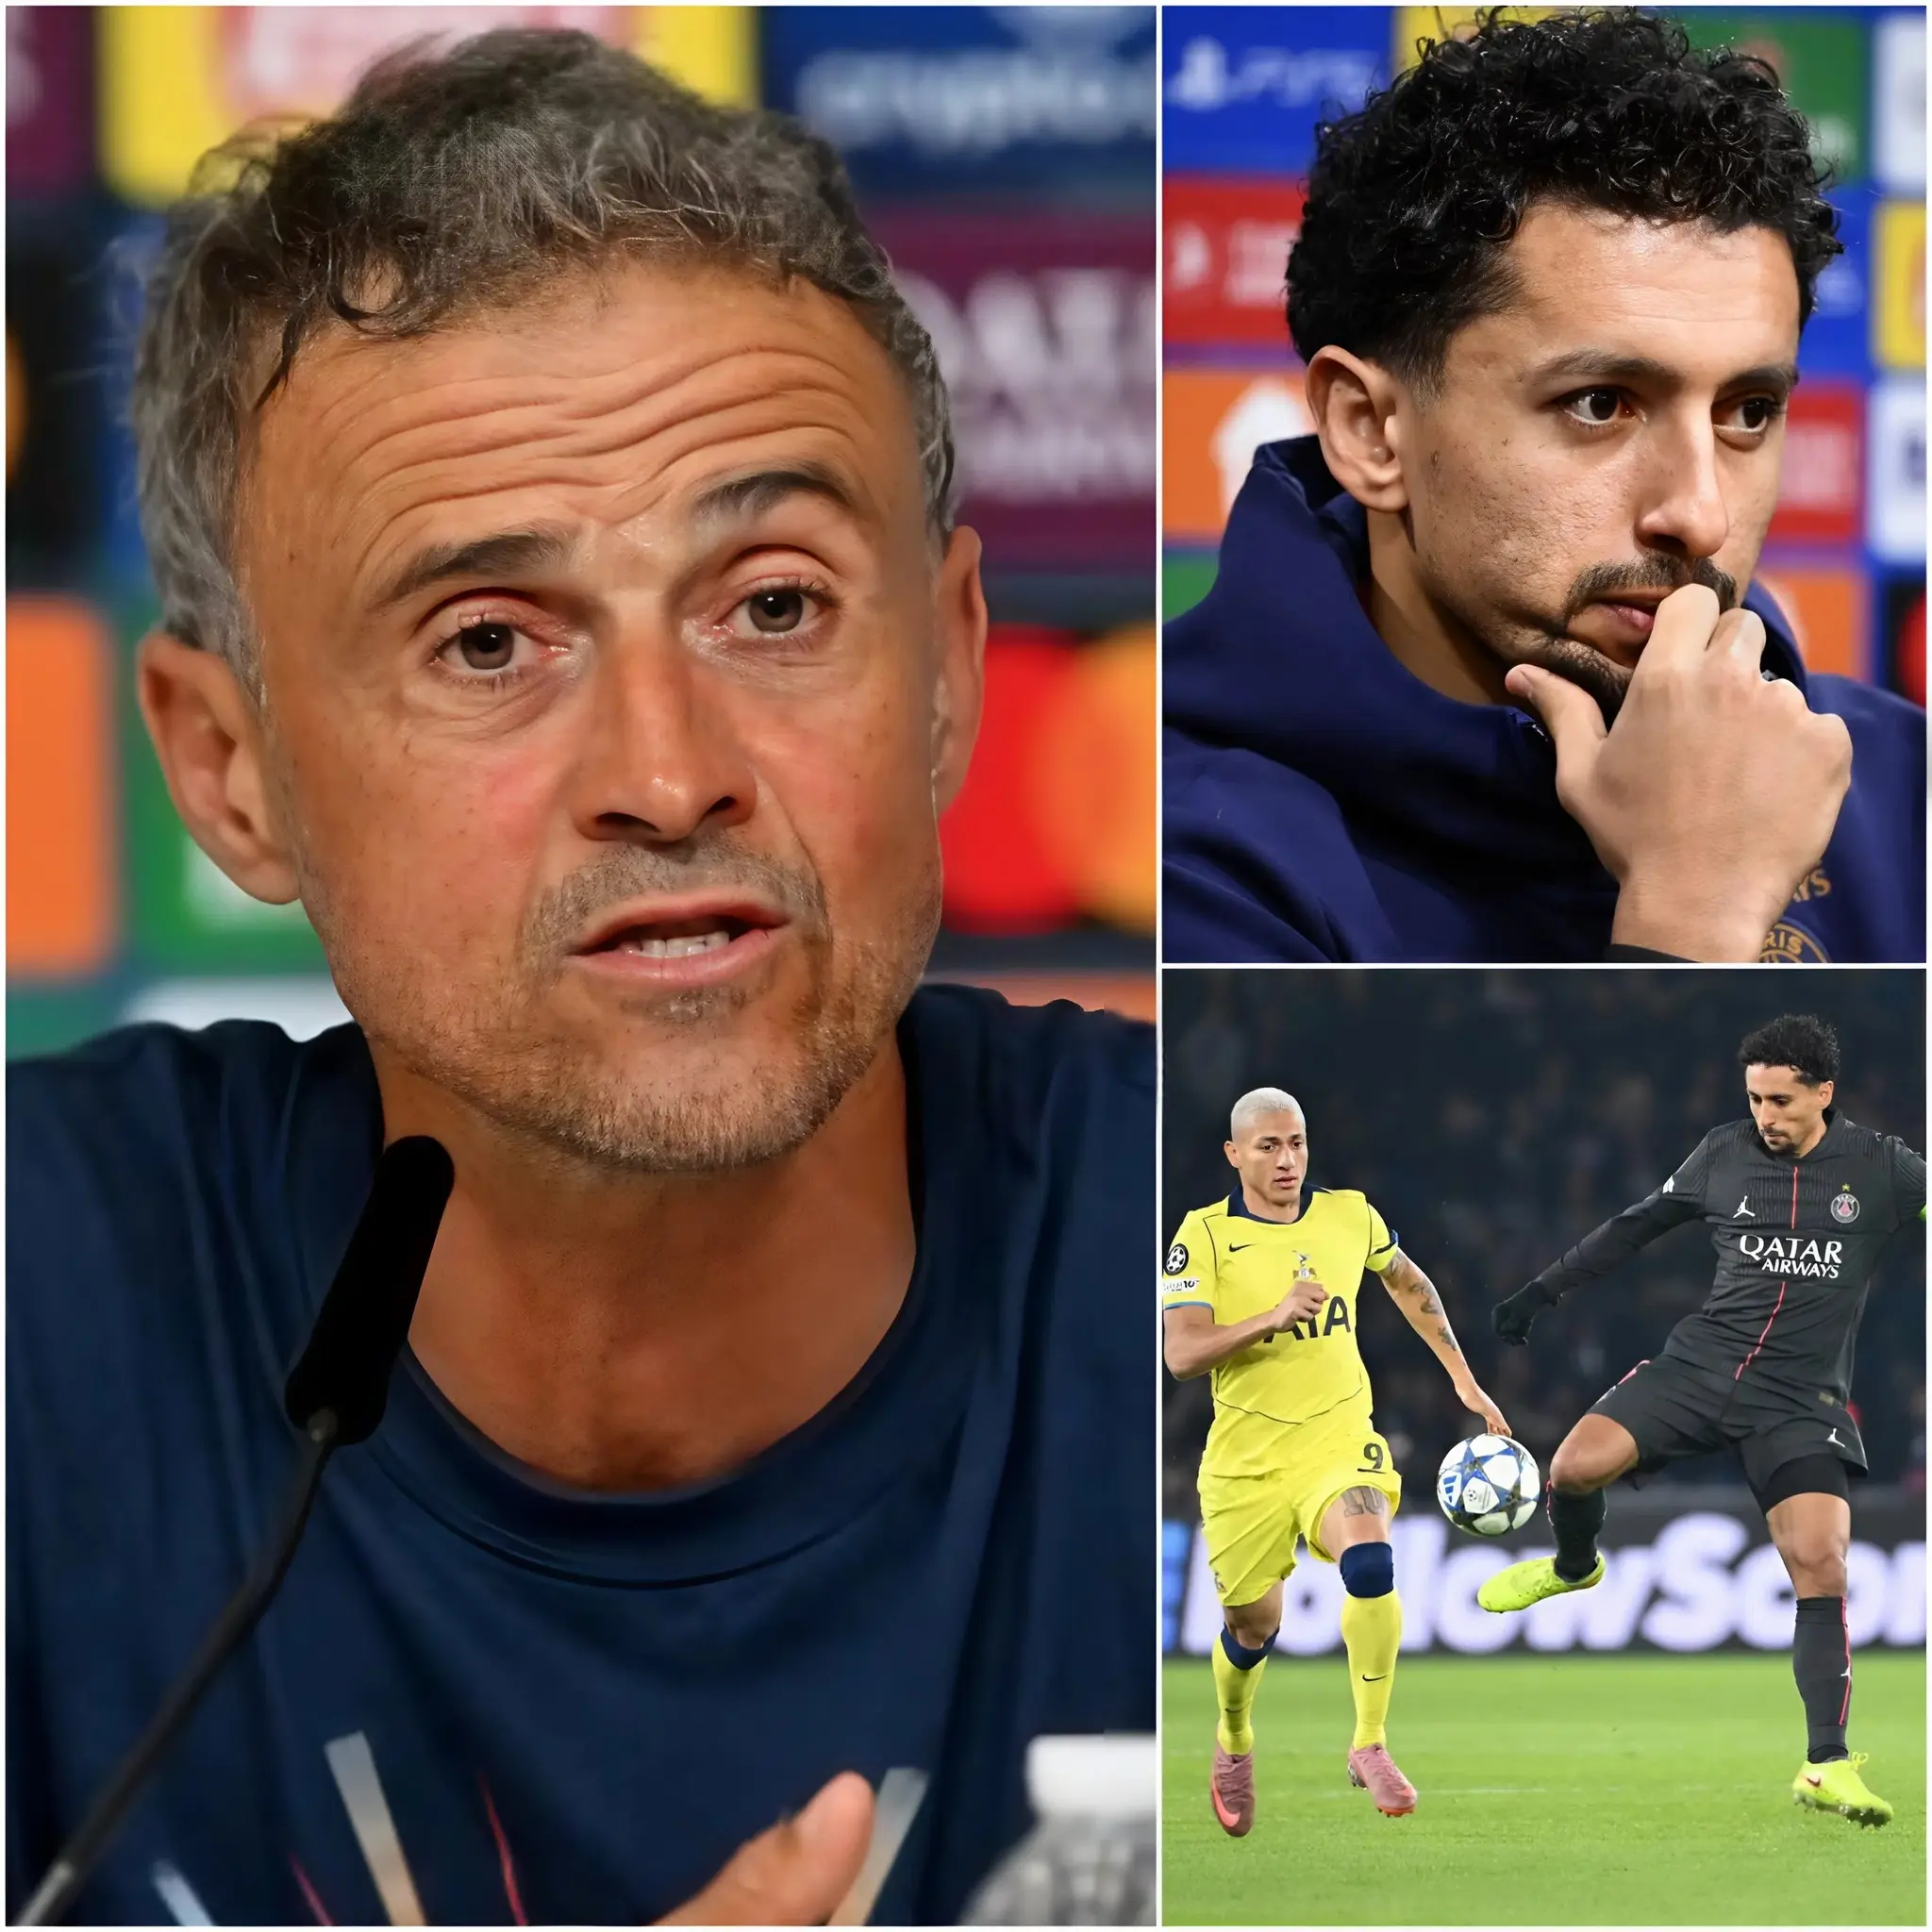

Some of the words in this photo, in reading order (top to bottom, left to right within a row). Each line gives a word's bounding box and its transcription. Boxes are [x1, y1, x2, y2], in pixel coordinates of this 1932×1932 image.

[1740, 1234, 1842, 1265] QATAR
[1761, 1257, 1840, 1279] AIRWAYS
[1363, 1442, 1384, 1471] 9
